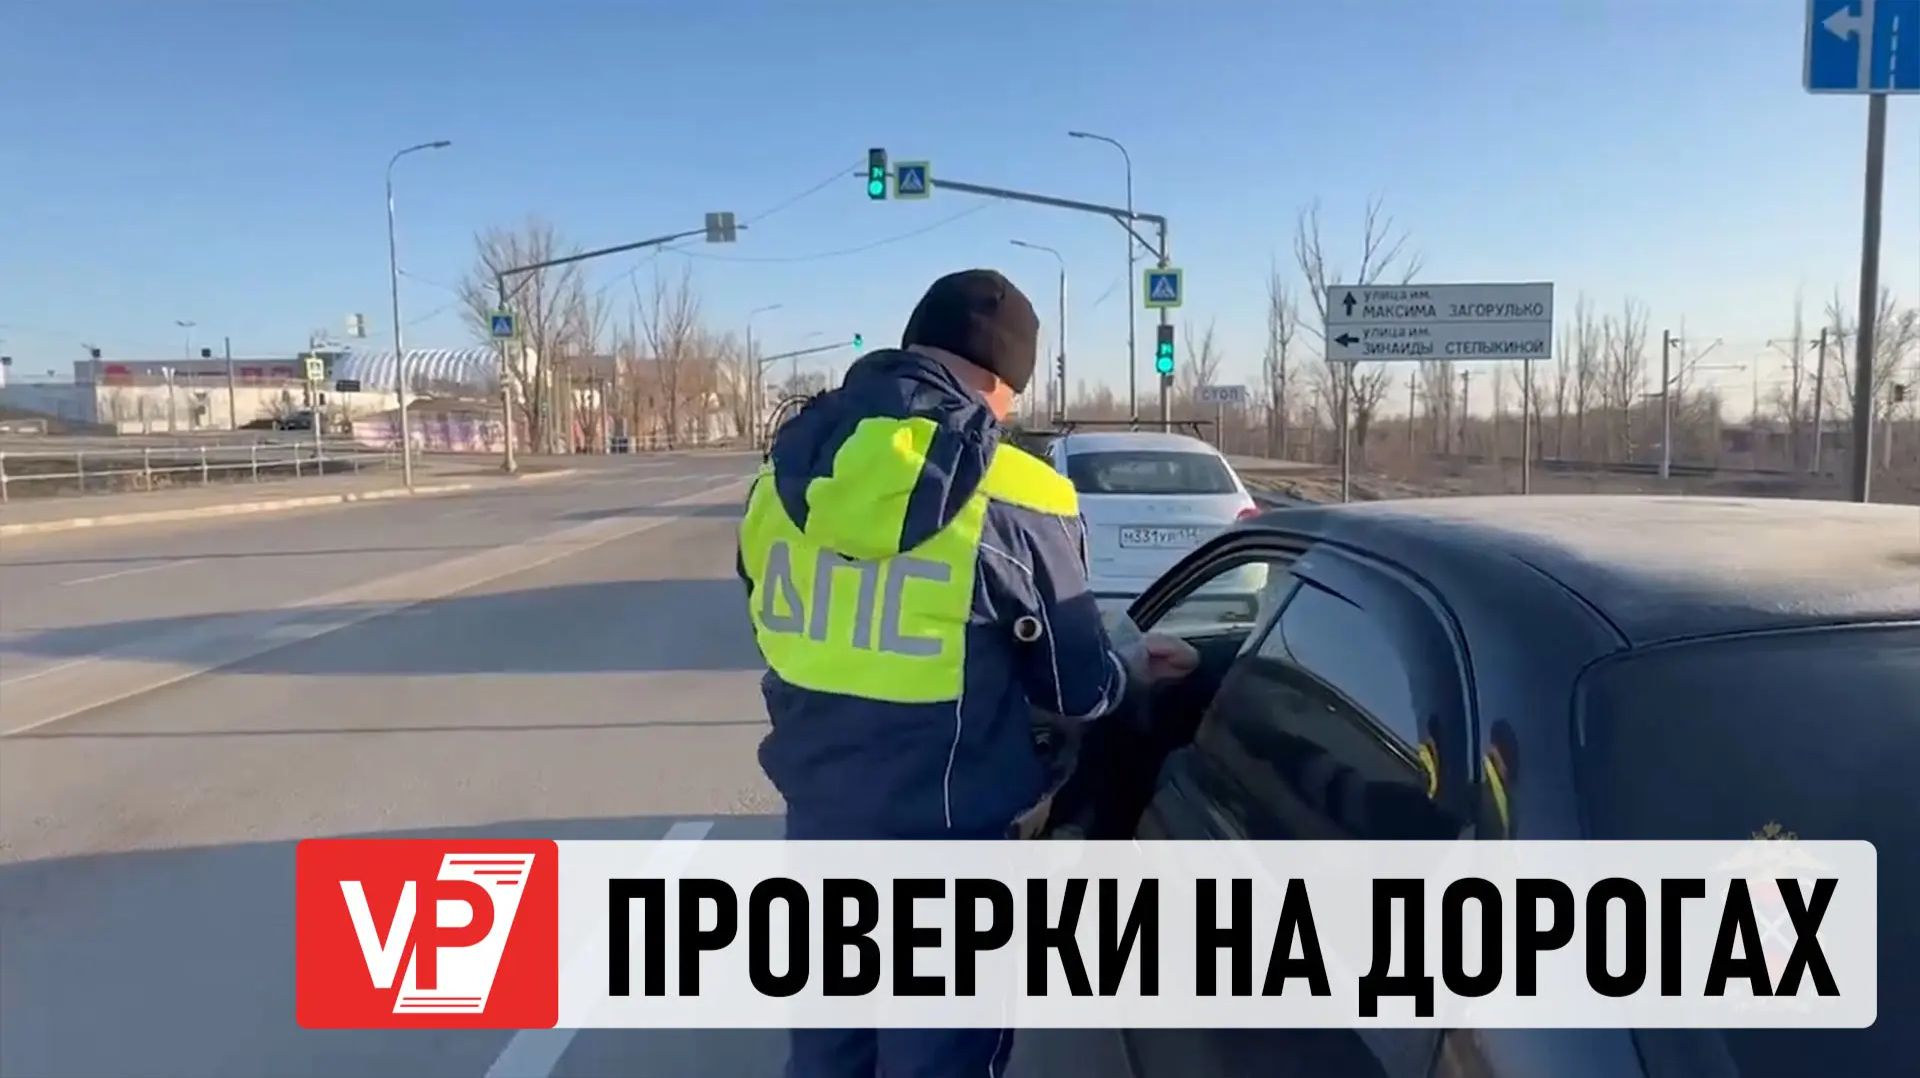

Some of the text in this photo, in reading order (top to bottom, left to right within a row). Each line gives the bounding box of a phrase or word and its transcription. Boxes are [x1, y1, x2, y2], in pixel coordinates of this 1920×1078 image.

[1362, 302, 1544, 318] МАКСИМА ЗАГОРУЛЬКО
[1362, 339, 1545, 355] ЗИНАИДЫ СТЕПЫКИНОЙ
[759, 541, 951, 657] ДПС
